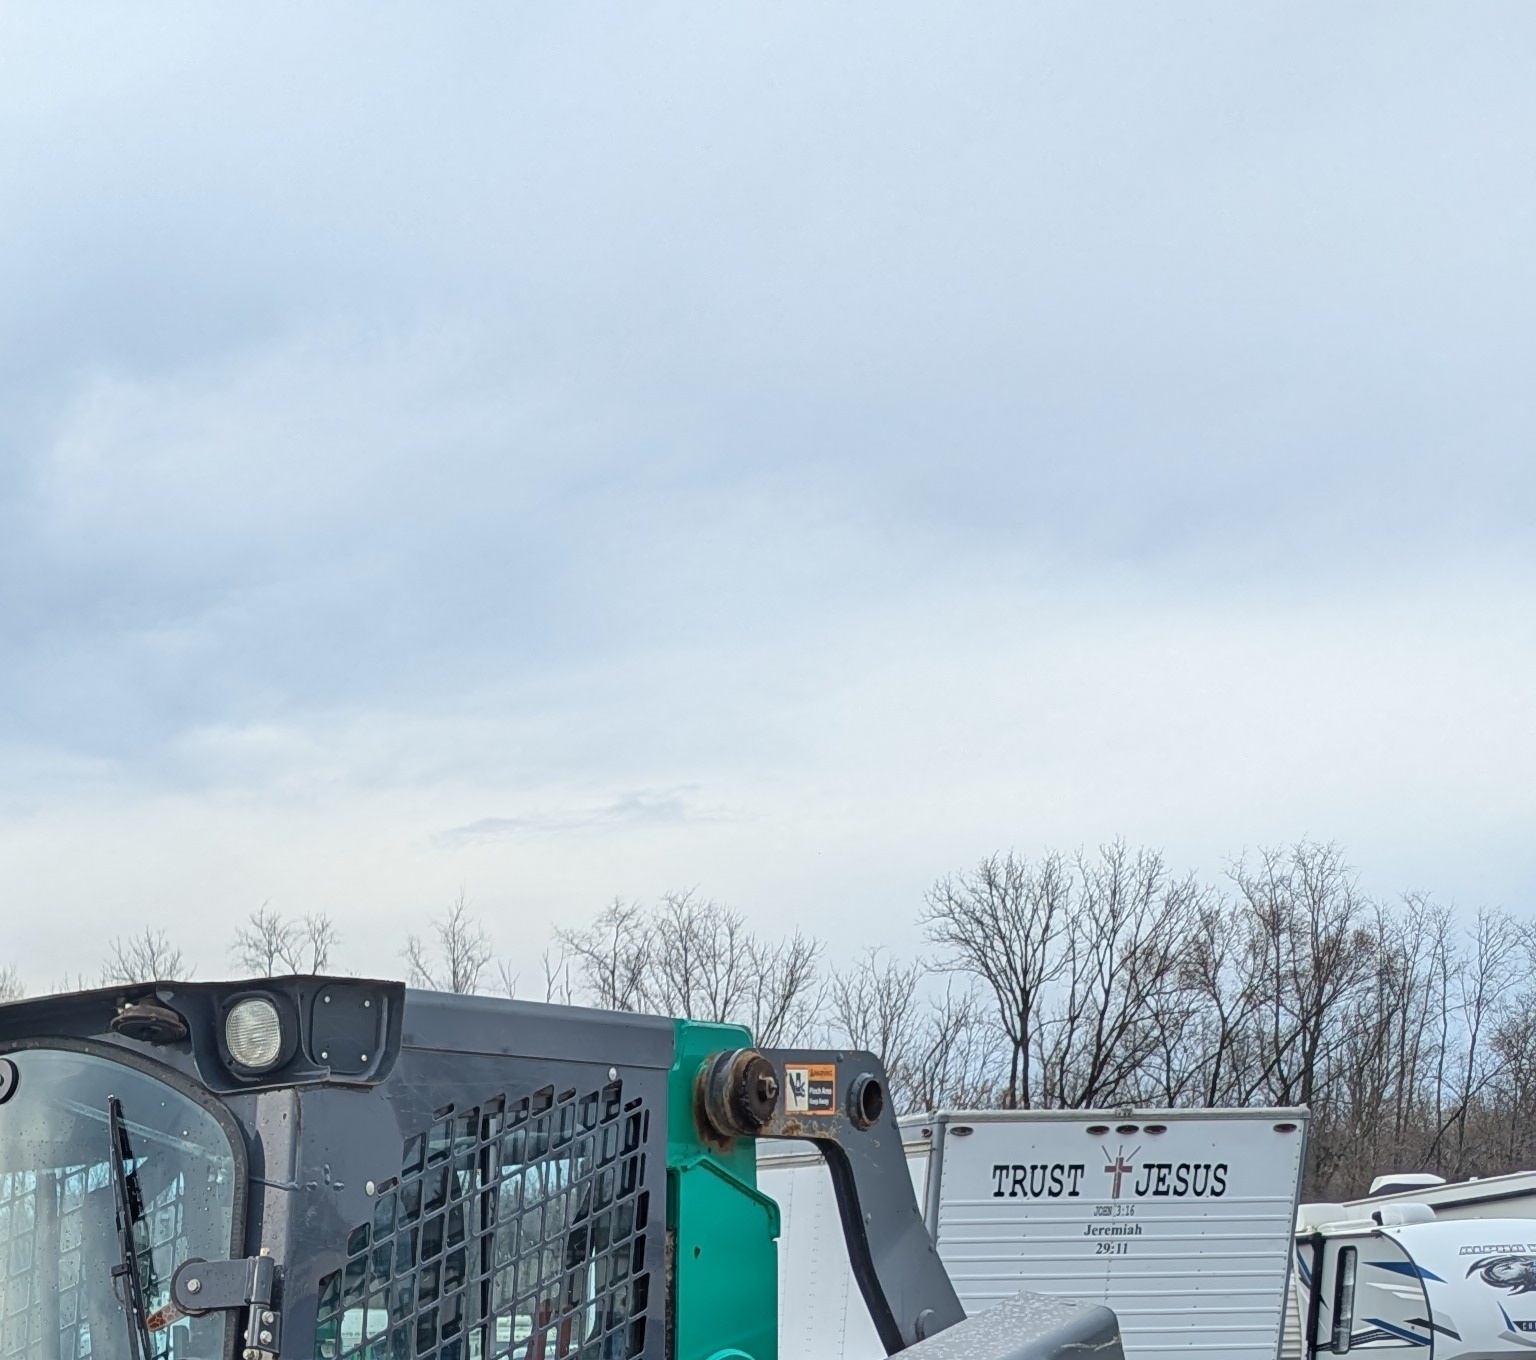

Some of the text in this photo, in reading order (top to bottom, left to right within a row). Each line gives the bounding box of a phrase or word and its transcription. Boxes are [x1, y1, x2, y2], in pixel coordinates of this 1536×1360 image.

[992, 1163, 1229, 1198] TRUST JESUS
[1115, 1204, 1135, 1217] 3:16
[1083, 1224, 1143, 1237] Jeremiah
[1095, 1242, 1128, 1255] 29:11
[1459, 1244, 1526, 1256] ALPHA
